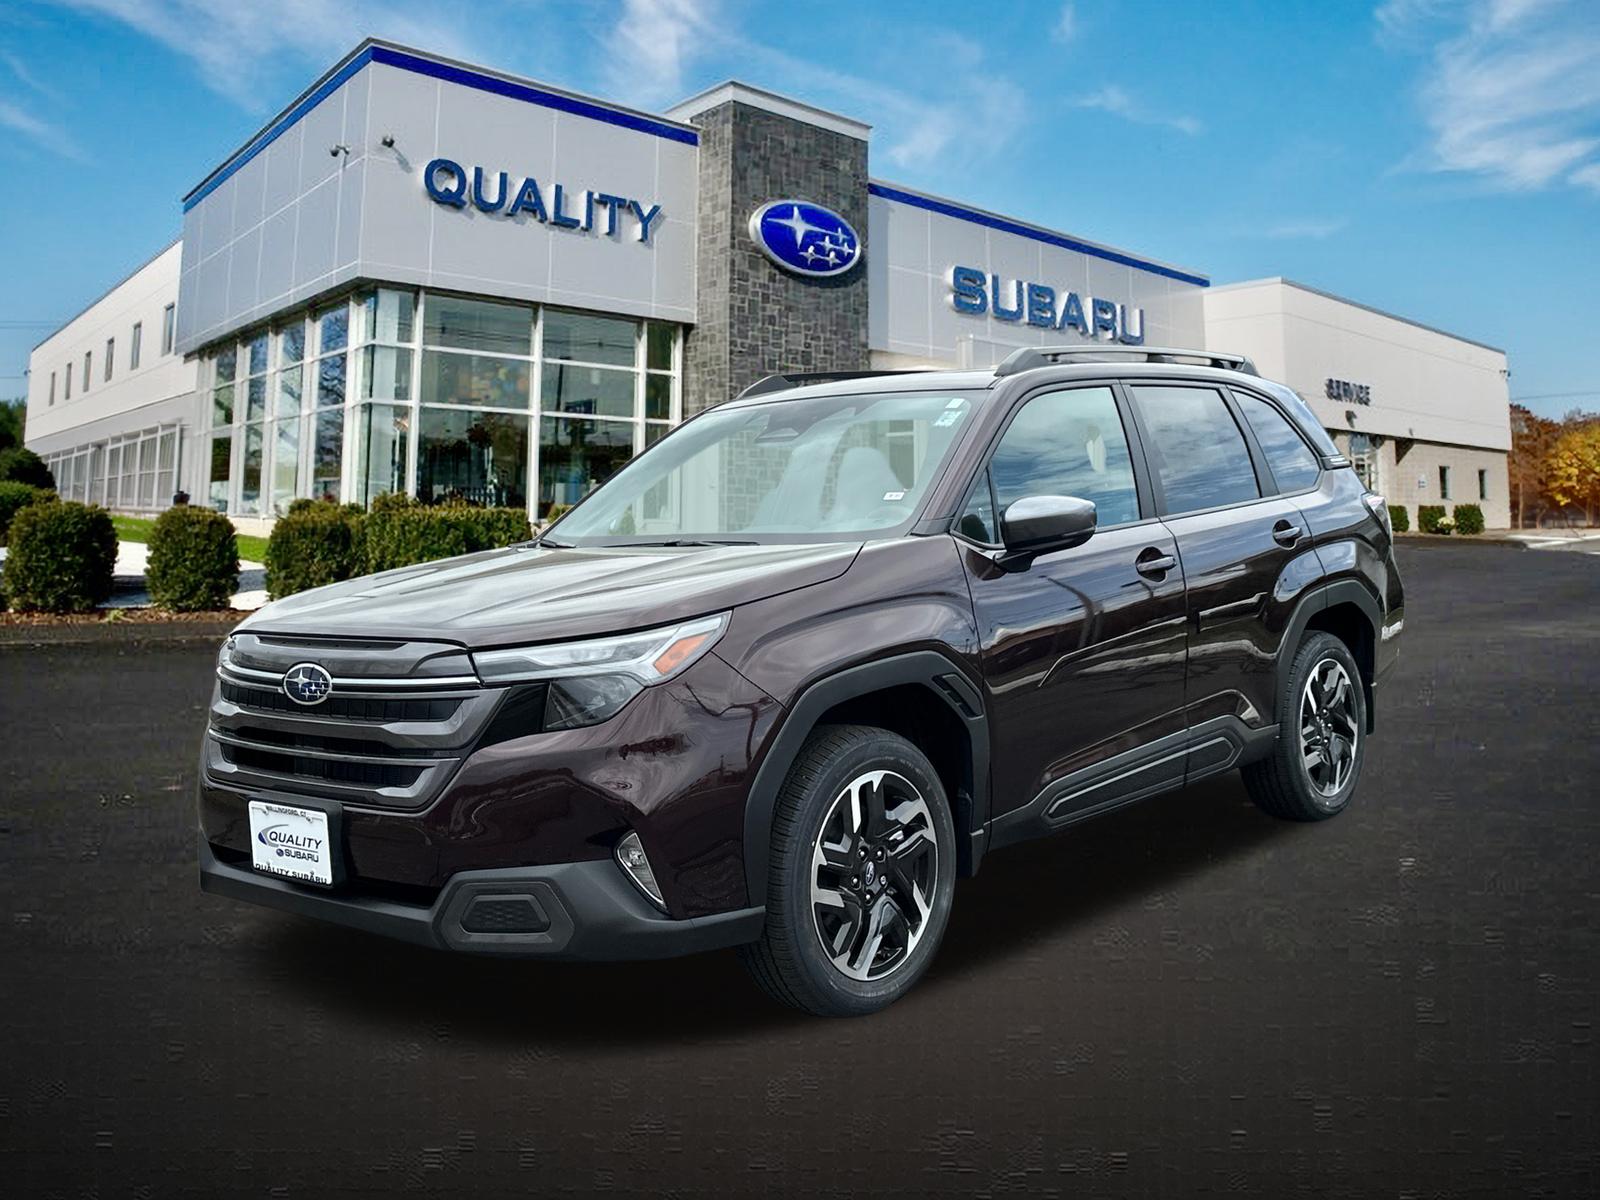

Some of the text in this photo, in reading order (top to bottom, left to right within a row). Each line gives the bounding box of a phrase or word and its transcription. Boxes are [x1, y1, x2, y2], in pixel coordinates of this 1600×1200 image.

[424, 158, 661, 243] QUALITY
[951, 265, 1145, 345] SUBARU
[1325, 378, 1370, 406] SERVICE
[269, 831, 322, 849] QUALITY
[284, 849, 319, 863] SUBARU
[255, 863, 290, 876] QUALITY
